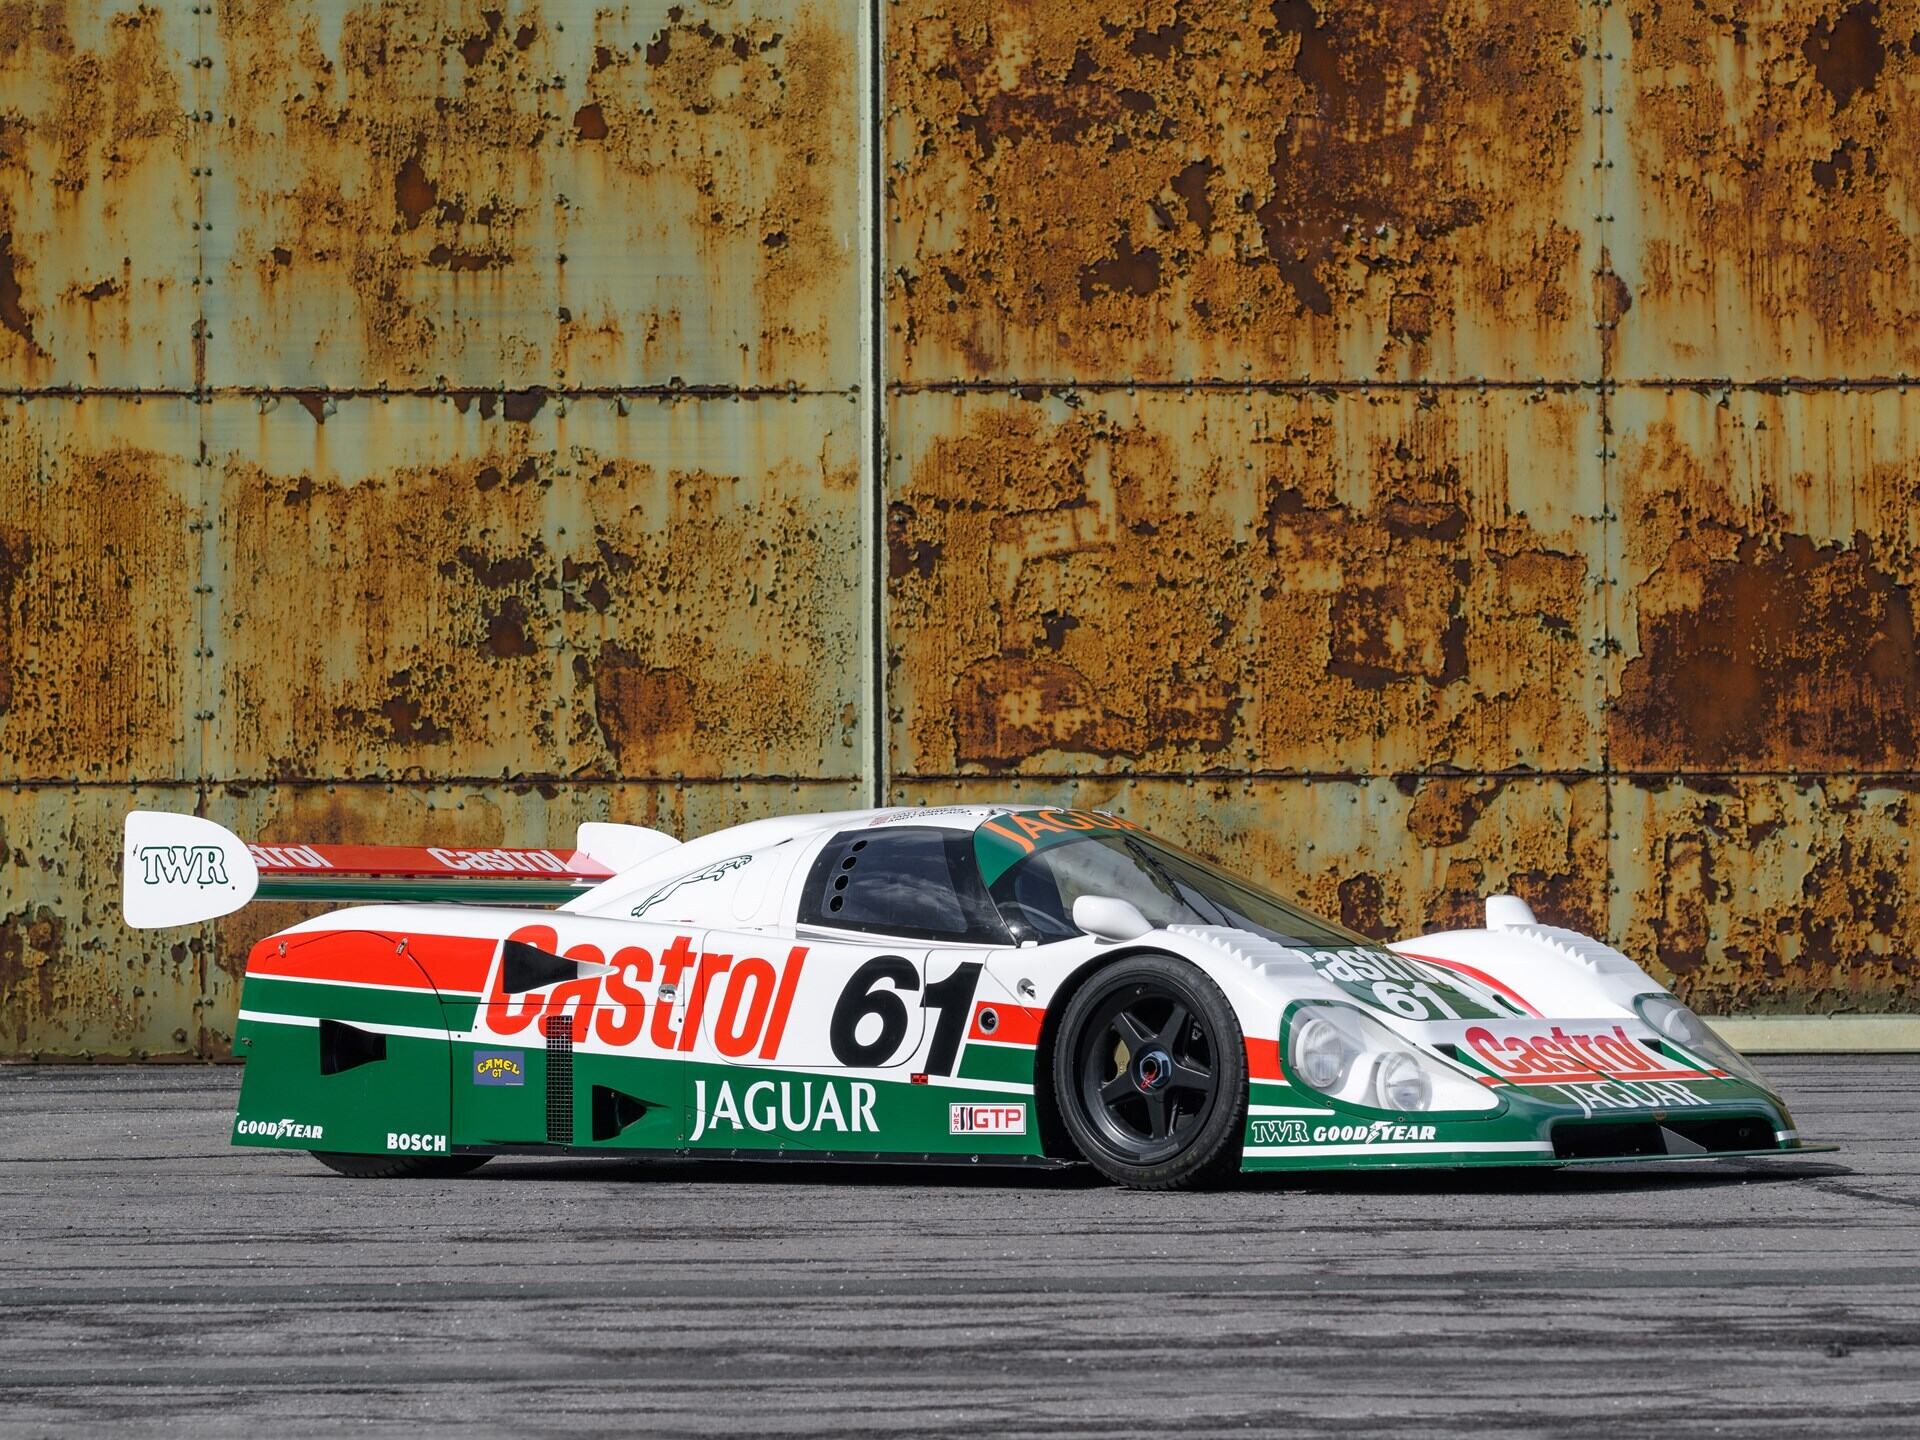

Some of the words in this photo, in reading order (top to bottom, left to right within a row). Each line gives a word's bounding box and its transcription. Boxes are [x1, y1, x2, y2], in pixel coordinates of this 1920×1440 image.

[140, 845, 229, 884] TWR
[426, 848, 577, 872] Castrol
[486, 924, 810, 1060] Castrol
[1372, 981, 1462, 1021] 61
[830, 954, 984, 1078] 61
[477, 1058, 521, 1075] CAMEL
[1464, 1025, 1668, 1075] Castrol
[492, 1068, 502, 1078] GT
[689, 1080, 880, 1141] JAGUAR
[974, 1109, 1021, 1128] GTP
[1549, 1081, 1712, 1119] JAGUAR
[386, 1132, 447, 1152] BOSCH
[1251, 1120, 1310, 1143] TWR
